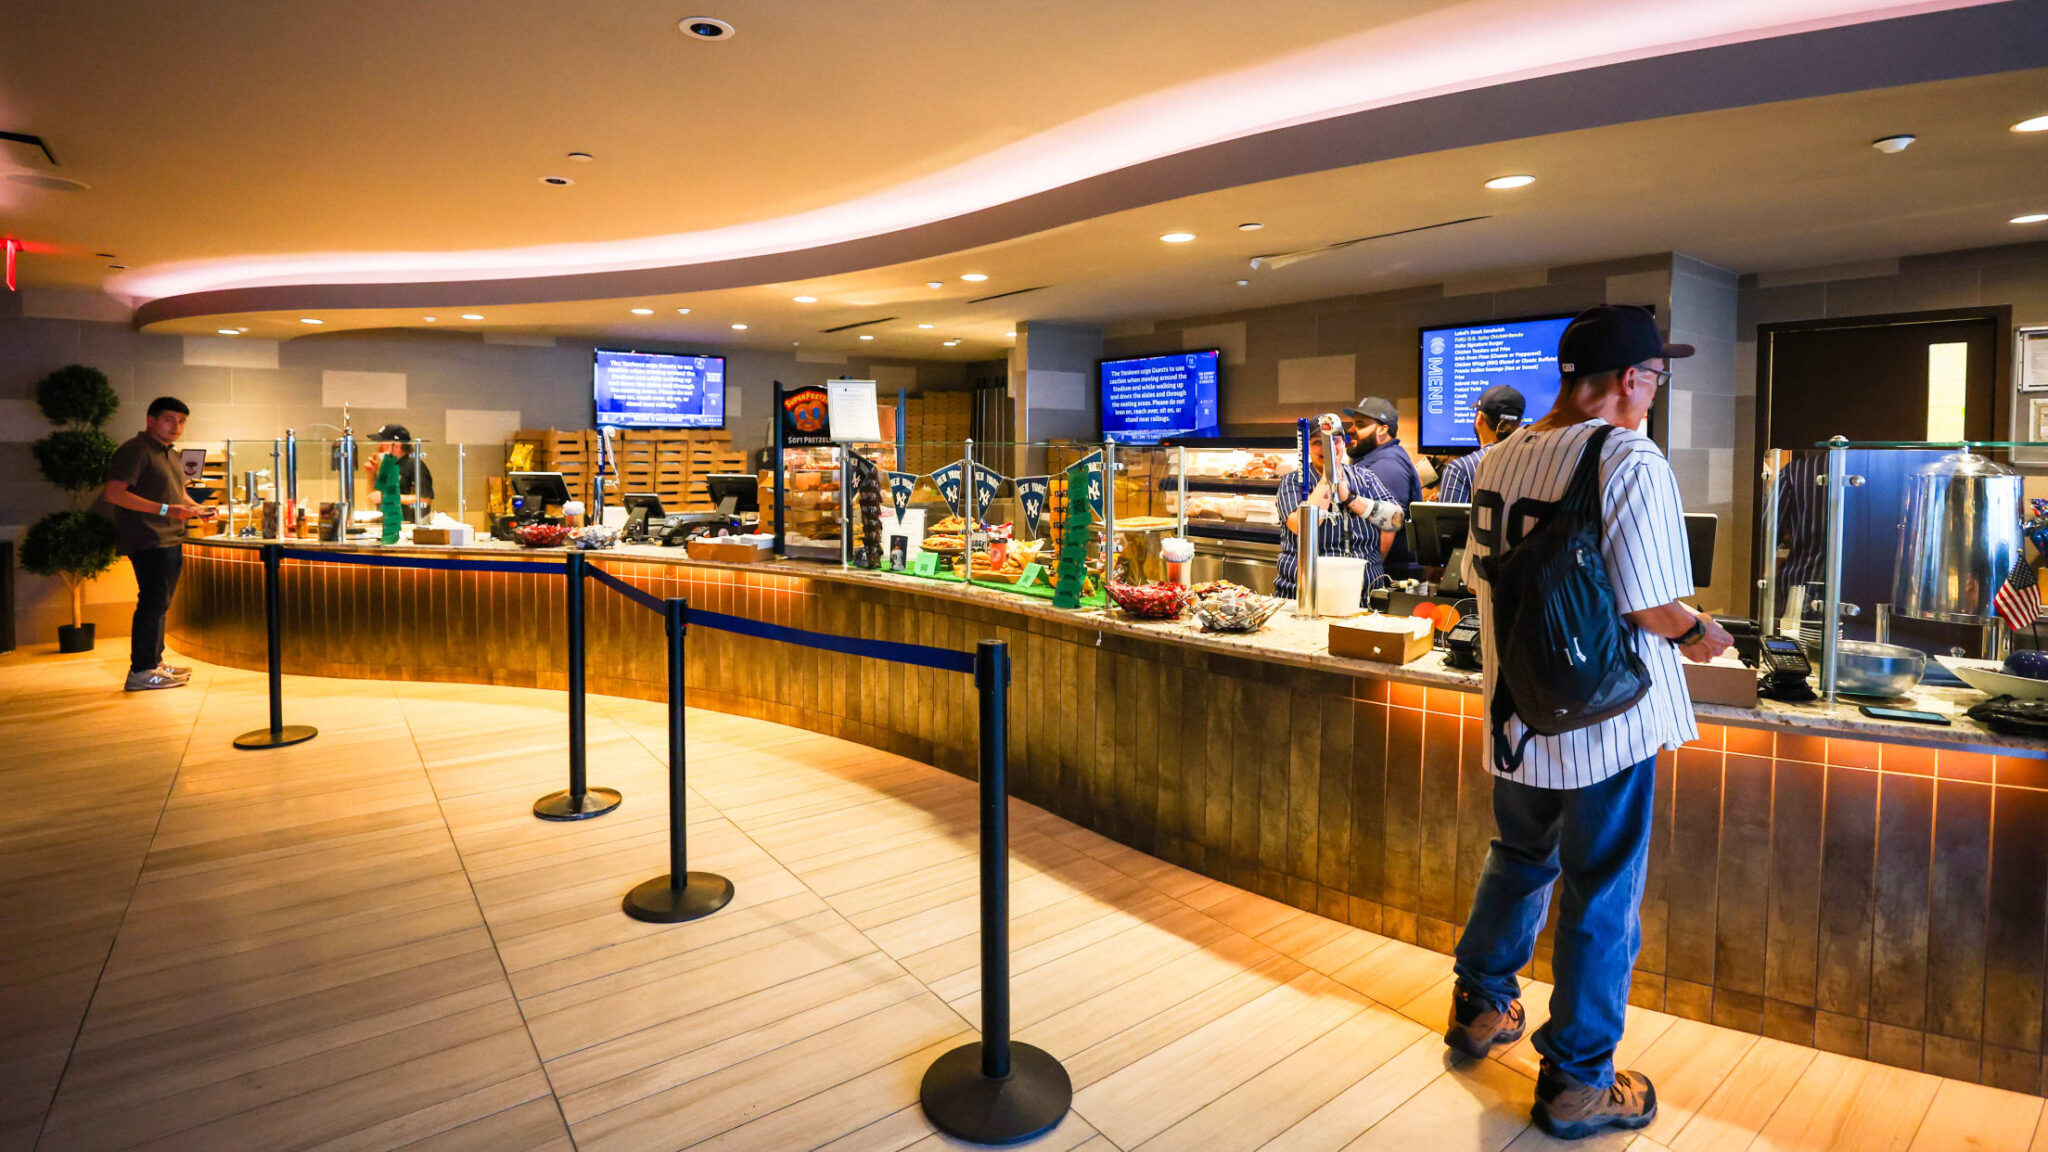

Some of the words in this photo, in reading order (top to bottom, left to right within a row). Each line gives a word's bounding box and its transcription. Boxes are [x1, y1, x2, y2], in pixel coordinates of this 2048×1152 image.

[1428, 357, 1443, 414] MENU
[784, 391, 828, 409] SUPERPRETZ
[788, 436, 803, 444] SOFT
